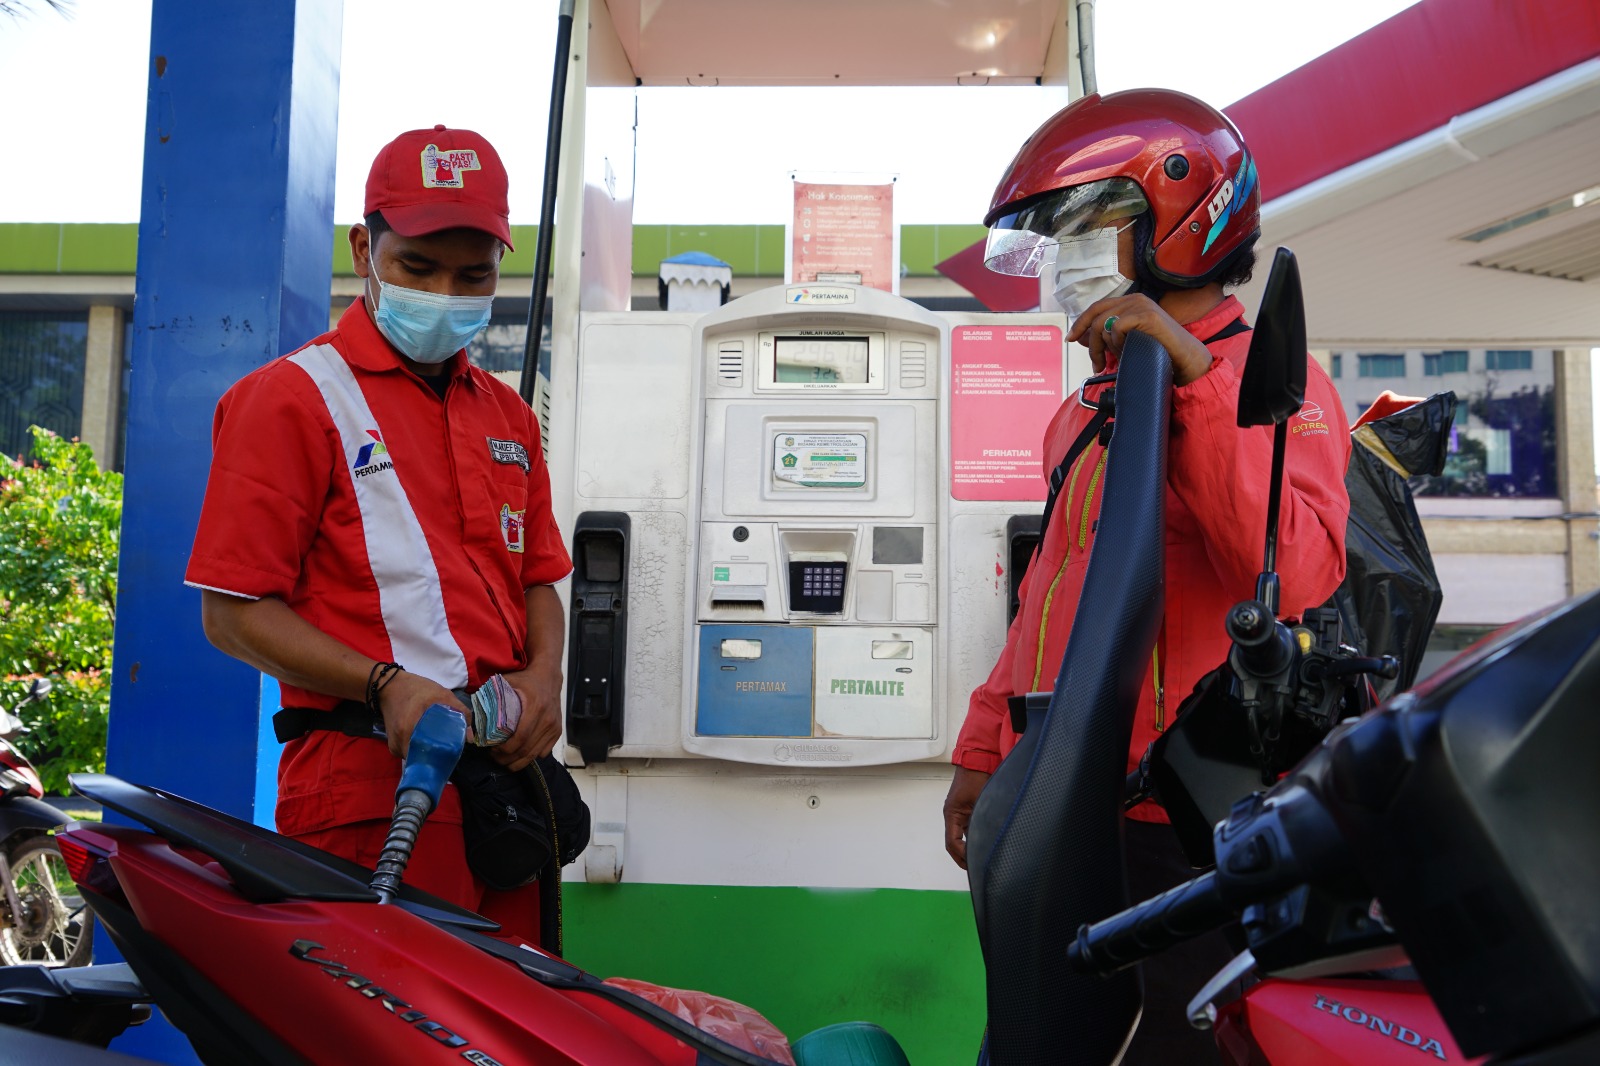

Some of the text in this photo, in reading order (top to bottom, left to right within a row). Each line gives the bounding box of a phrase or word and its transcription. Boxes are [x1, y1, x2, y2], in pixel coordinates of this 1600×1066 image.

[808, 191, 826, 200] Hak
[735, 681, 787, 693] PERTAMAX
[830, 679, 905, 697] PERTALITE
[793, 744, 839, 752] GILBARCO
[794, 753, 853, 762] VEEDER-ROOT
[1313, 993, 1448, 1061] HONDA
